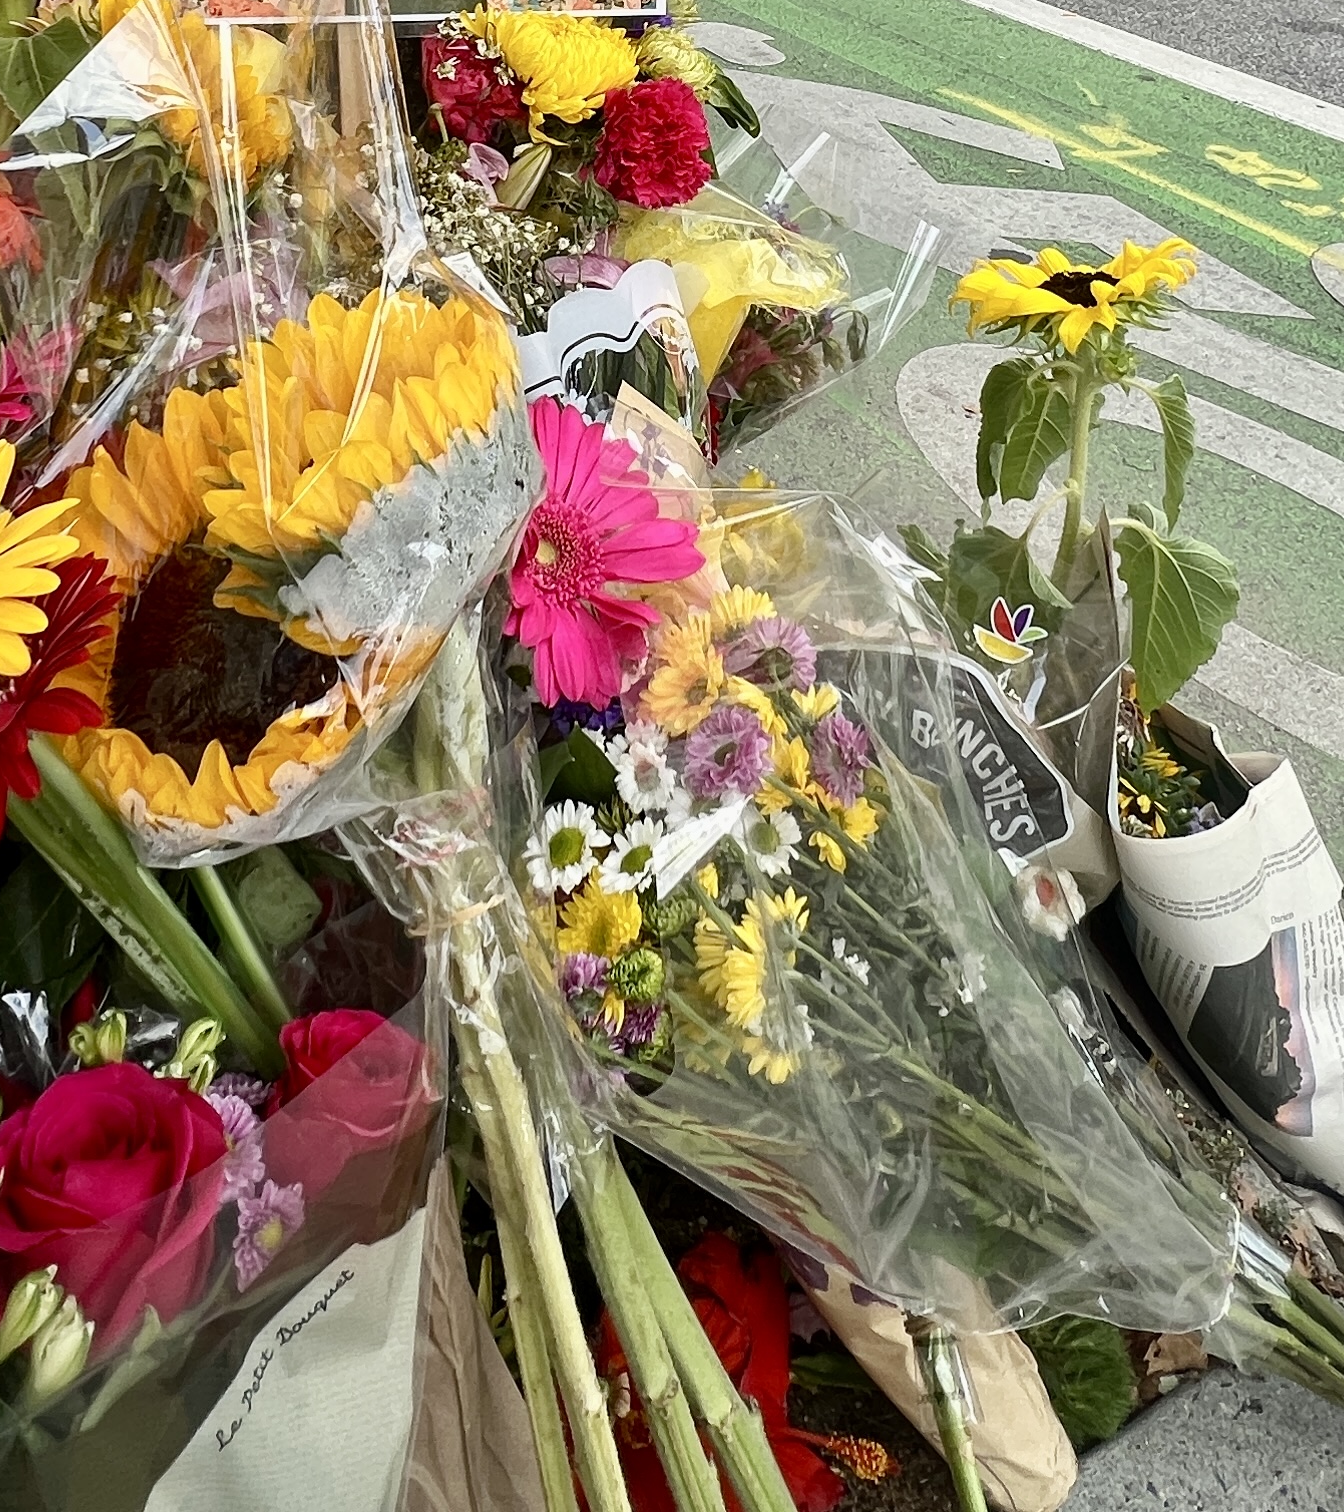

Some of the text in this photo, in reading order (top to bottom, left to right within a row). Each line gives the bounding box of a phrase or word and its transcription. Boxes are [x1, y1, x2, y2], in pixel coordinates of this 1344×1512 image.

[216, 1270, 354, 1453] Le Petit Bouquet
